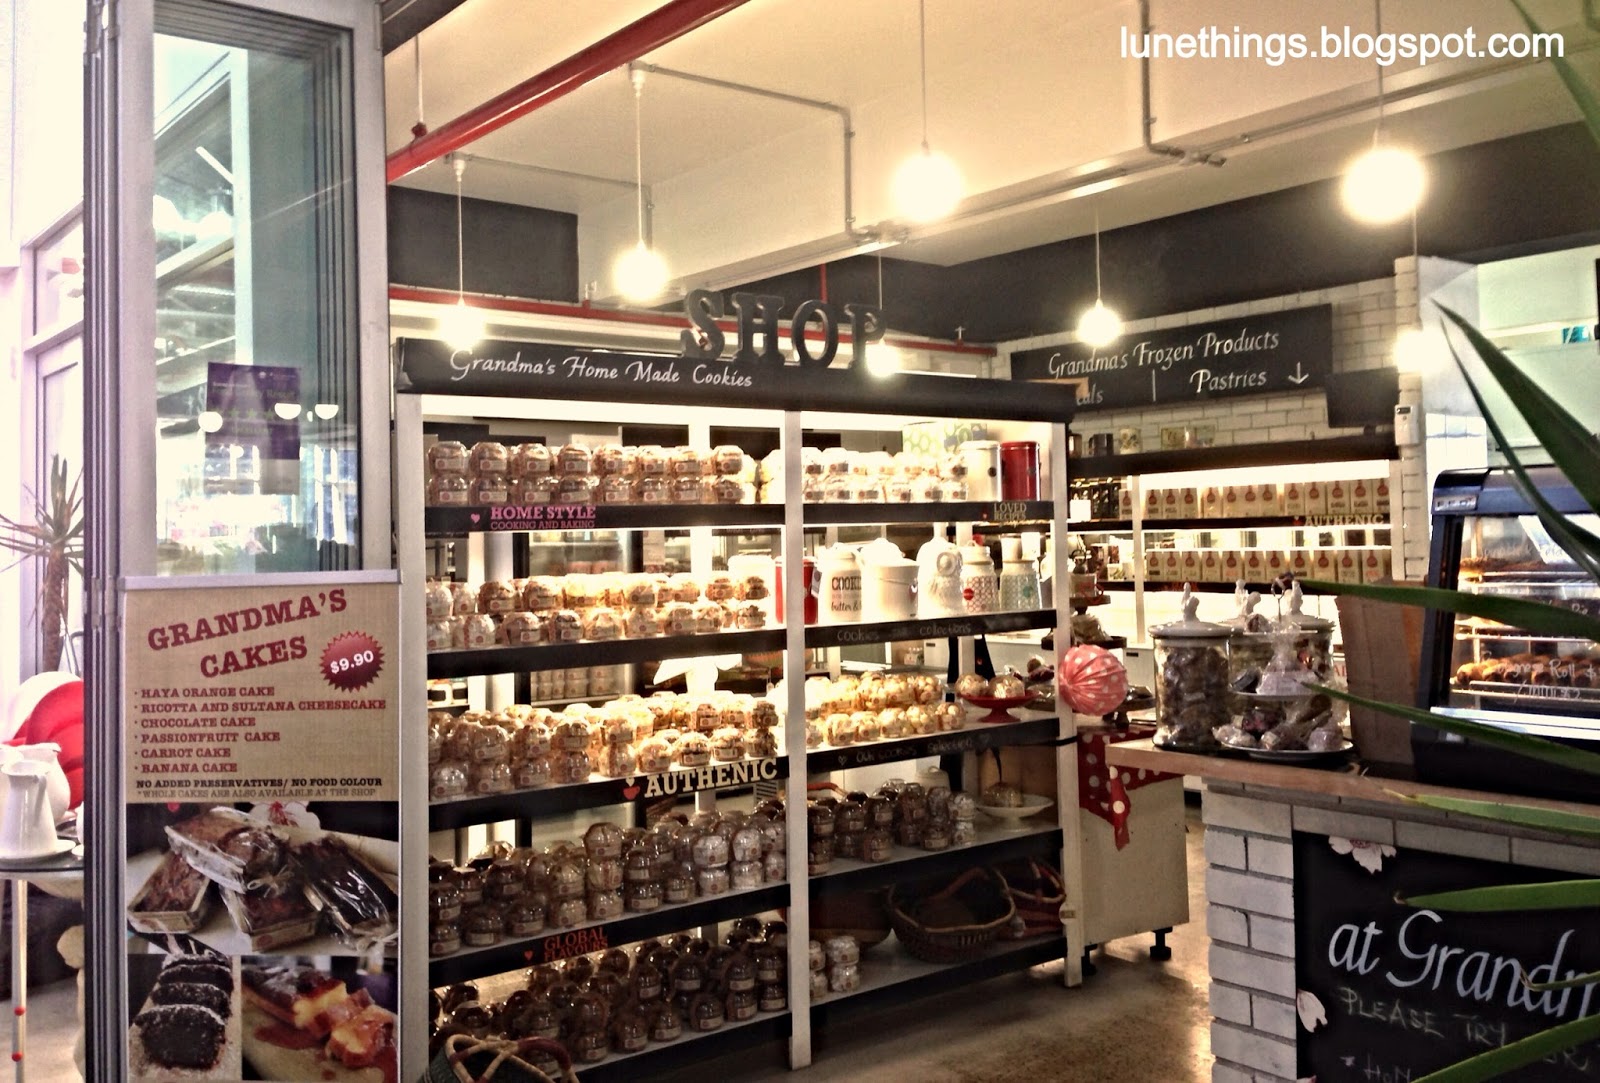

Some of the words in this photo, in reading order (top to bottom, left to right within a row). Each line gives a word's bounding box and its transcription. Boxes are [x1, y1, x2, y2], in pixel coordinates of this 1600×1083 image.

[679, 288, 887, 370] SHOP
[1132, 341, 1193, 371] Frozen
[1196, 328, 1280, 358] Products
[450, 350, 555, 381] Grandma's
[562, 356, 618, 380] Home
[624, 361, 681, 384] Made
[692, 364, 753, 388] Cookies
[1189, 368, 1267, 393] Pastries
[490, 506, 543, 520] HOME
[546, 506, 596, 519] STYLE
[993, 502, 1027, 513] LOVED
[490, 521, 536, 530] COOKING
[540, 521, 558, 529] AND
[561, 520, 595, 529] BAKING
[1303, 513, 1385, 527] AUTHENIC
[831, 576, 862, 591] COOKI
[148, 588, 347, 651] GRANDMA'S
[200, 636, 308, 678] CAKES
[330, 650, 375, 674] $9.90
[1549, 658, 1575, 678] Roll
[141, 688, 179, 698] HAYA
[183, 687, 236, 697] ORANGE
[240, 687, 275, 697] CAKE
[141, 703, 198, 713] RICOTTA
[201, 702, 229, 712] AND
[232, 701, 295, 712] SULTANA
[298, 700, 386, 711] CHEESECAKE
[141, 718, 217, 728] CHOCOLATE
[220, 717, 256, 727] CAKE
[141, 733, 239, 743] PASSIONFRUIT
[244, 732, 280, 742] CAKE
[141, 748, 193, 758] CARROT
[195, 748, 231, 758] CAKE
[141, 764, 199, 773] BANANA
[202, 763, 238, 773] CAKE
[136, 780, 152, 788] NO
[154, 779, 191, 788] ADDED
[291, 779, 307, 788] NO
[310, 778, 337, 787] FOOD
[340, 778, 382, 787] COLOUR
[644, 758, 778, 798] AUTHENIC
[178, 790, 209, 798] CAKES
[210, 789, 230, 798] ARE
[232, 789, 257, 797] ALSO
[258, 788, 314, 797] AVAILABLE
[315, 788, 327, 797] AT
[329, 788, 350, 797] THE
[351, 788, 376, 796] SHOP
[544, 926, 607, 951] GLOBAL
[544, 938, 608, 961] FLAVOURS
[1328, 921, 1383, 975] at
[1339, 986, 1445, 1039] PLEASE
[1453, 1012, 1507, 1047] TRY
